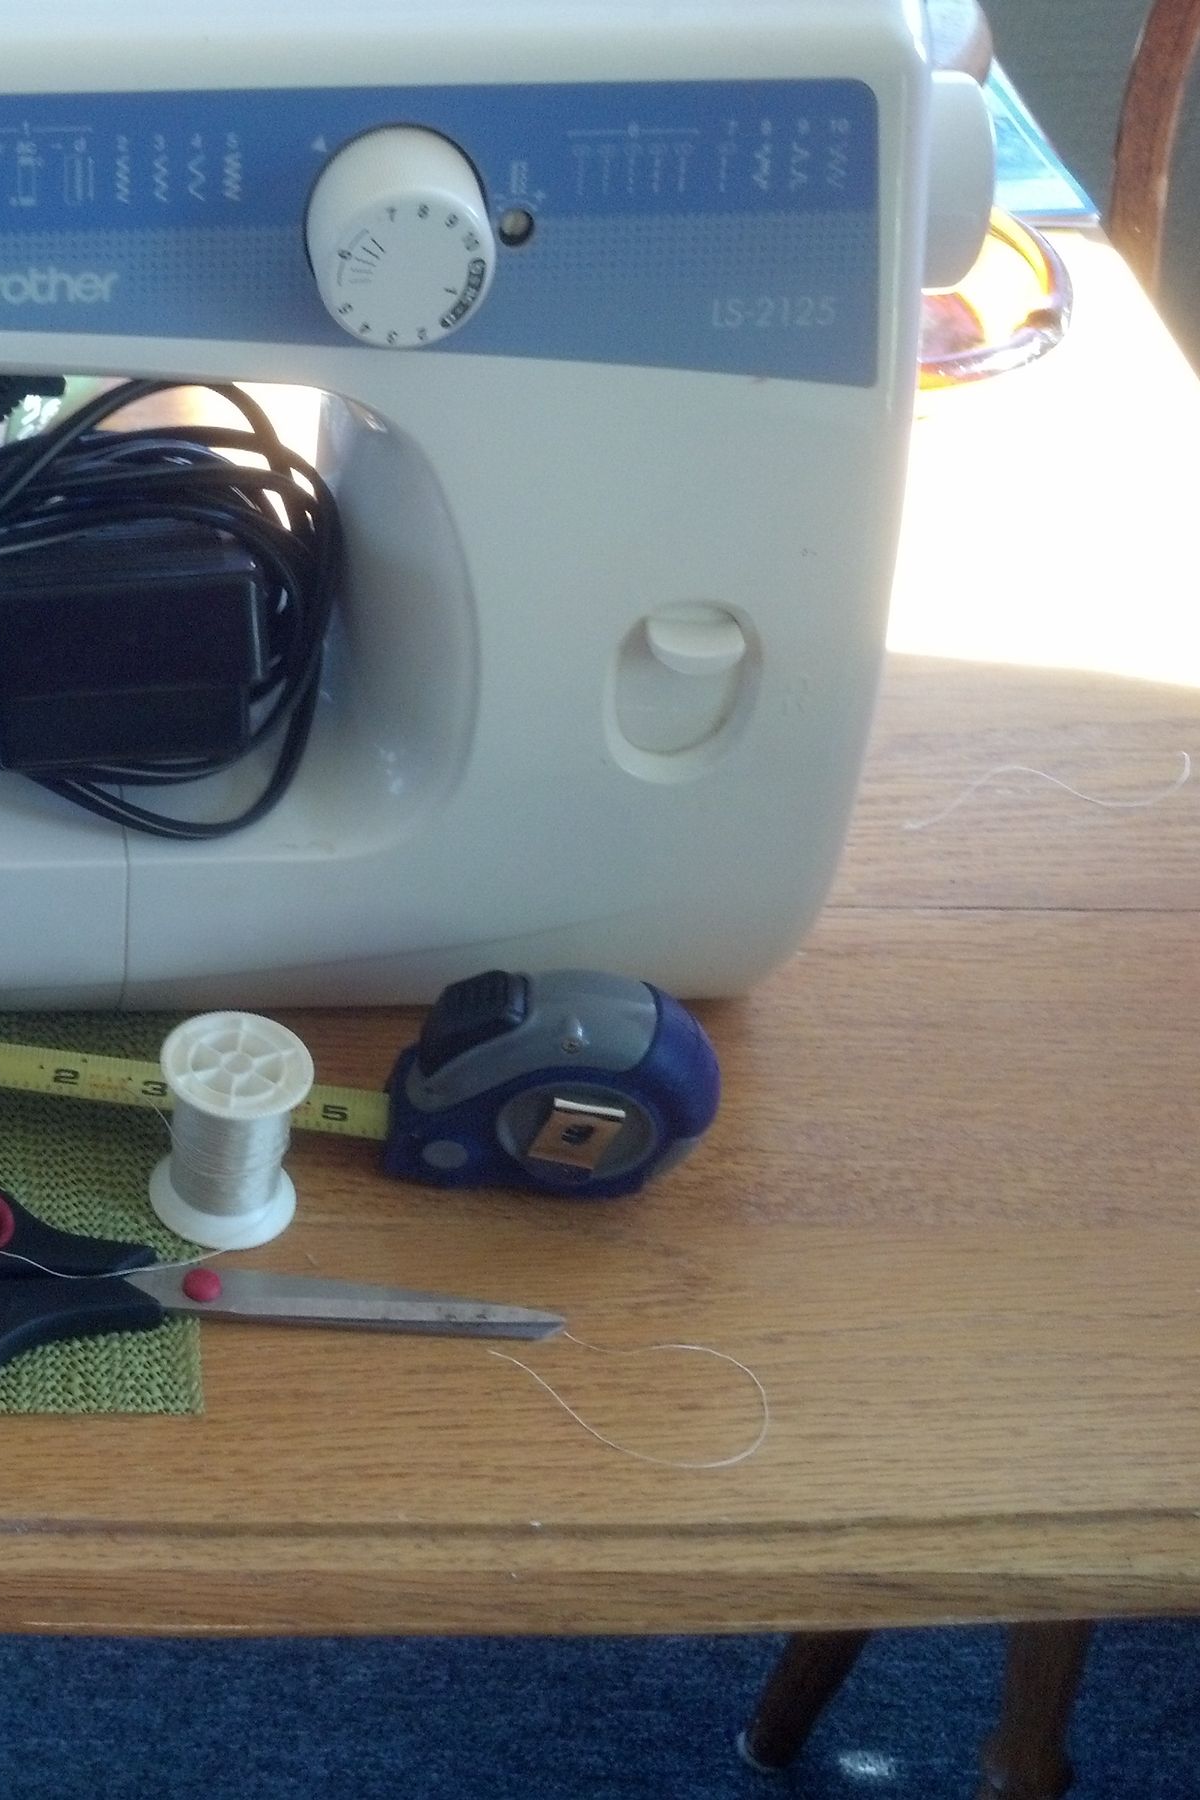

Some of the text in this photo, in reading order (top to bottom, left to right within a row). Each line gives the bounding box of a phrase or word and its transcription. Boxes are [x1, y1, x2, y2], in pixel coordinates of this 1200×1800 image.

[53, 1068, 79, 1085] 2
[141, 1080, 168, 1097] 3
[321, 1104, 348, 1122] 5
